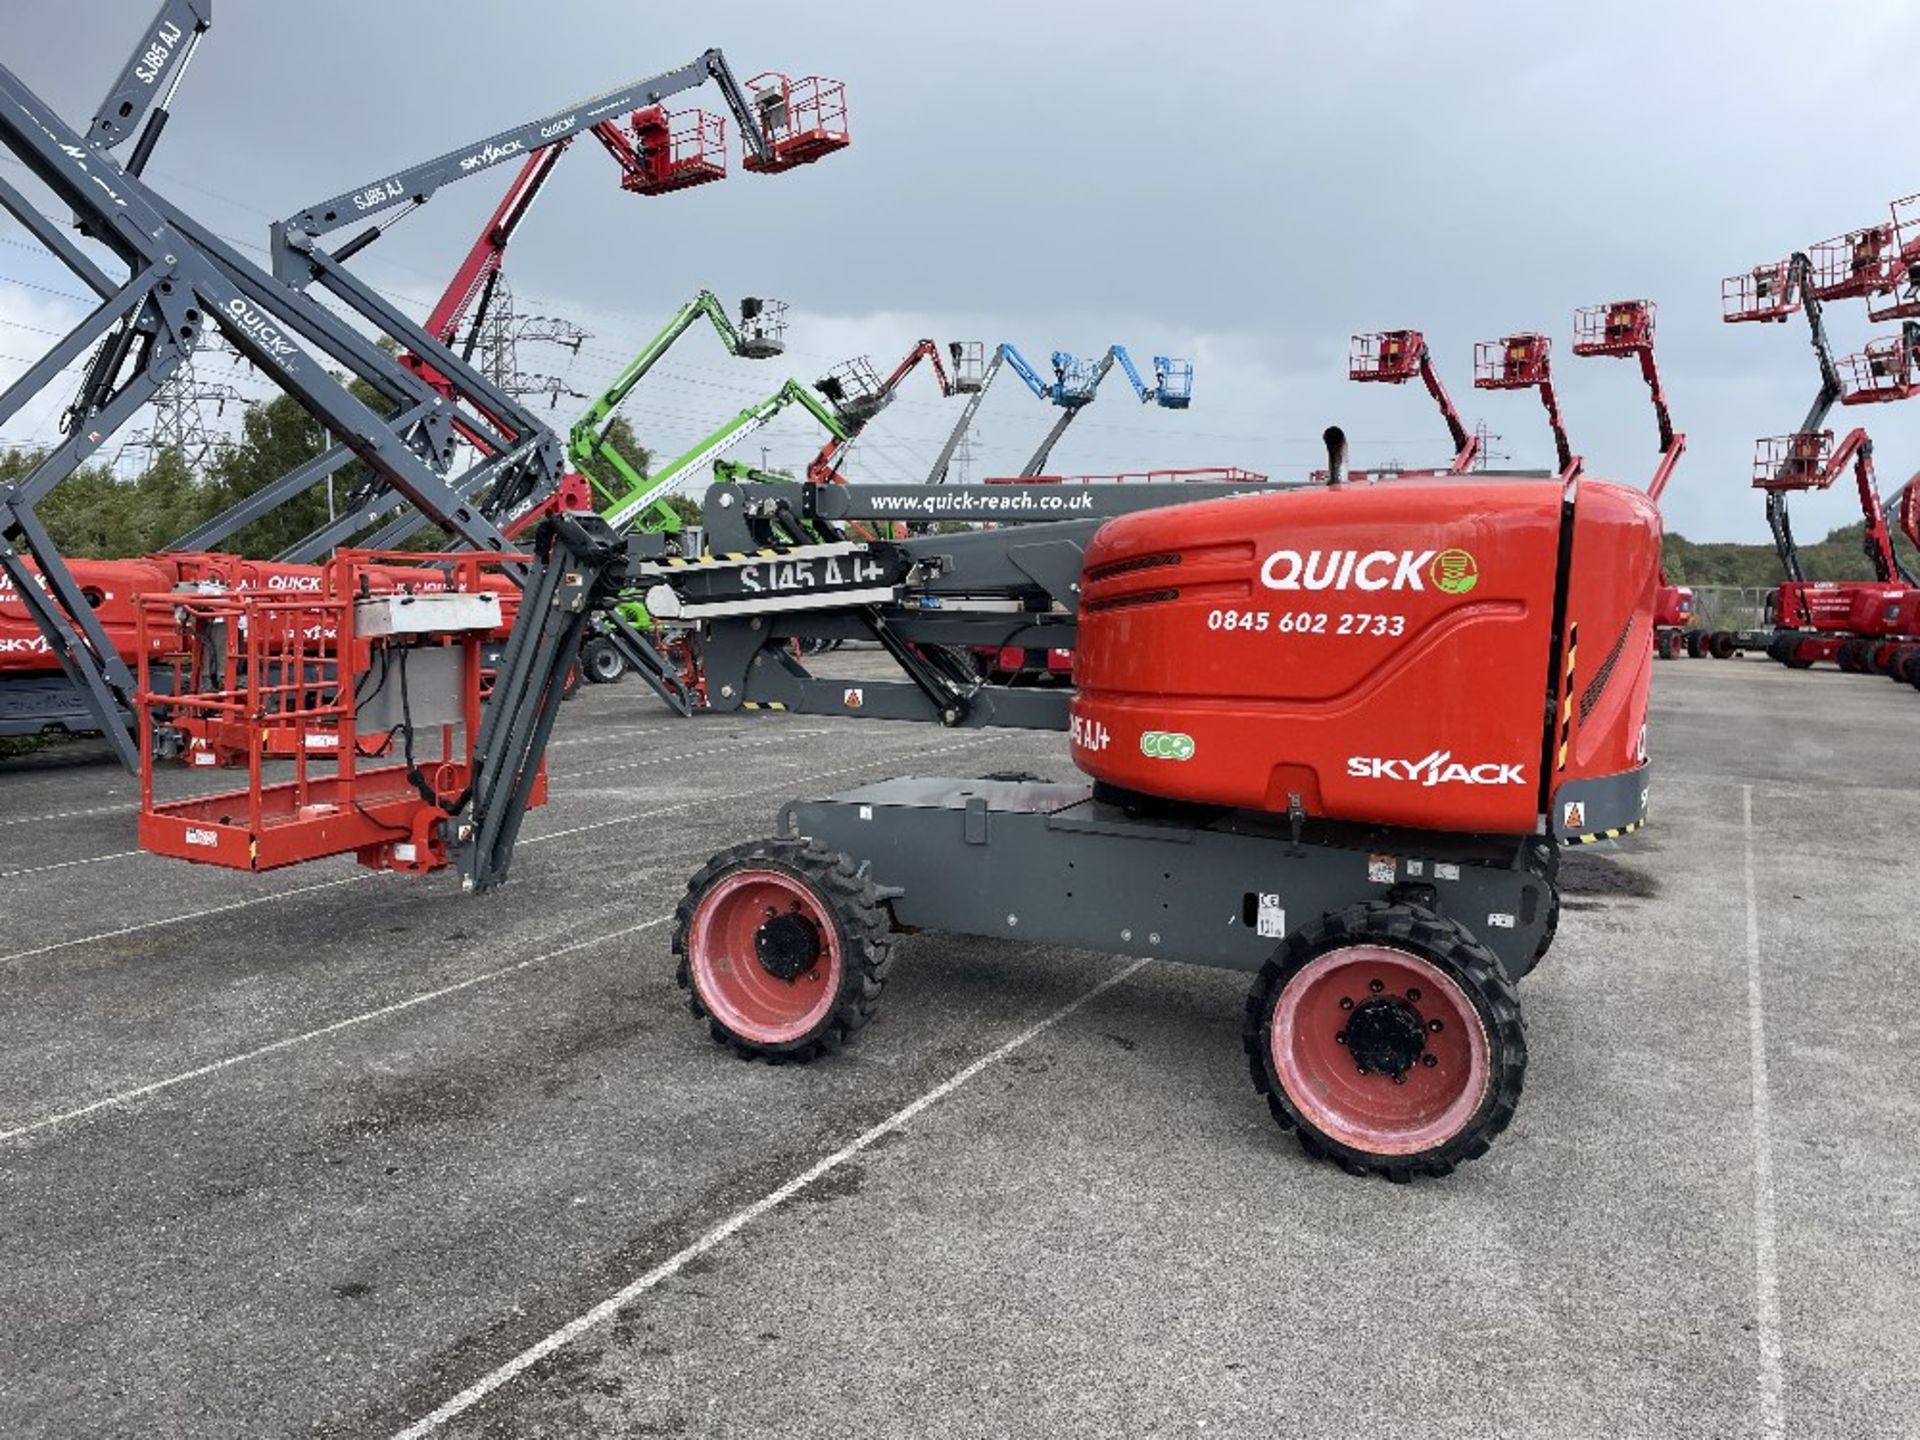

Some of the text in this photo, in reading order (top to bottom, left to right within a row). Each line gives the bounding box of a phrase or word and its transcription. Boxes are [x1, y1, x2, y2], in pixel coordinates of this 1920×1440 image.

[135, 20, 182, 85] SJ85 AJ
[459, 139, 525, 171] SKYJACK
[352, 179, 405, 211] SJ85 AJ
[230, 299, 290, 353] QUICK
[871, 491, 1094, 513] www.quick-reach.co.uk
[268, 575, 321, 590] QUICK
[1260, 549, 1437, 592] QUICK
[1208, 609, 1406, 637] 0845 602 2733
[1346, 750, 1527, 787] SKYJACK
